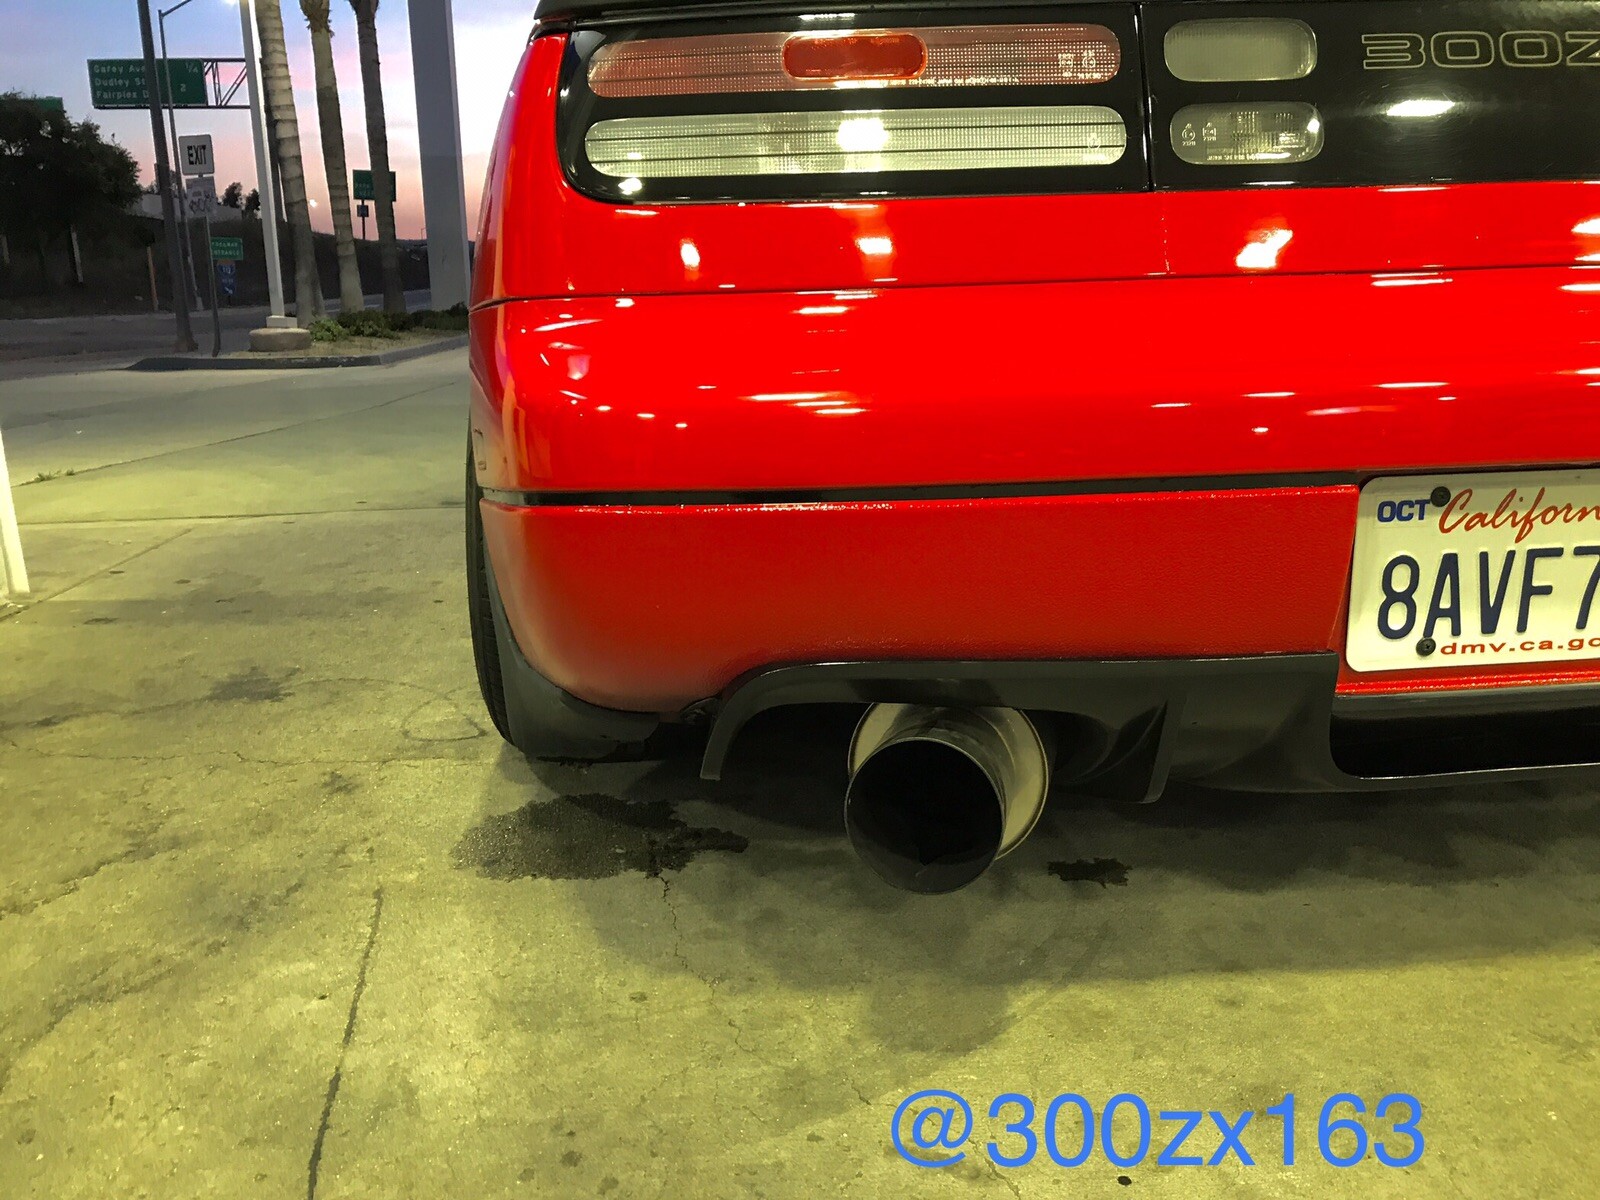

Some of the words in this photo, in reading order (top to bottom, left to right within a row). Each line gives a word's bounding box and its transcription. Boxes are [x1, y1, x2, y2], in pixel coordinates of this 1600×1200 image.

[93, 64, 123, 75] Garey
[94, 77, 129, 87] Dudley
[96, 90, 137, 100] Fairplex
[180, 83, 187, 92] 2
[187, 144, 207, 165] EXIT
[1376, 499, 1430, 523] OCT
[1377, 545, 1600, 640] 8AVF7
